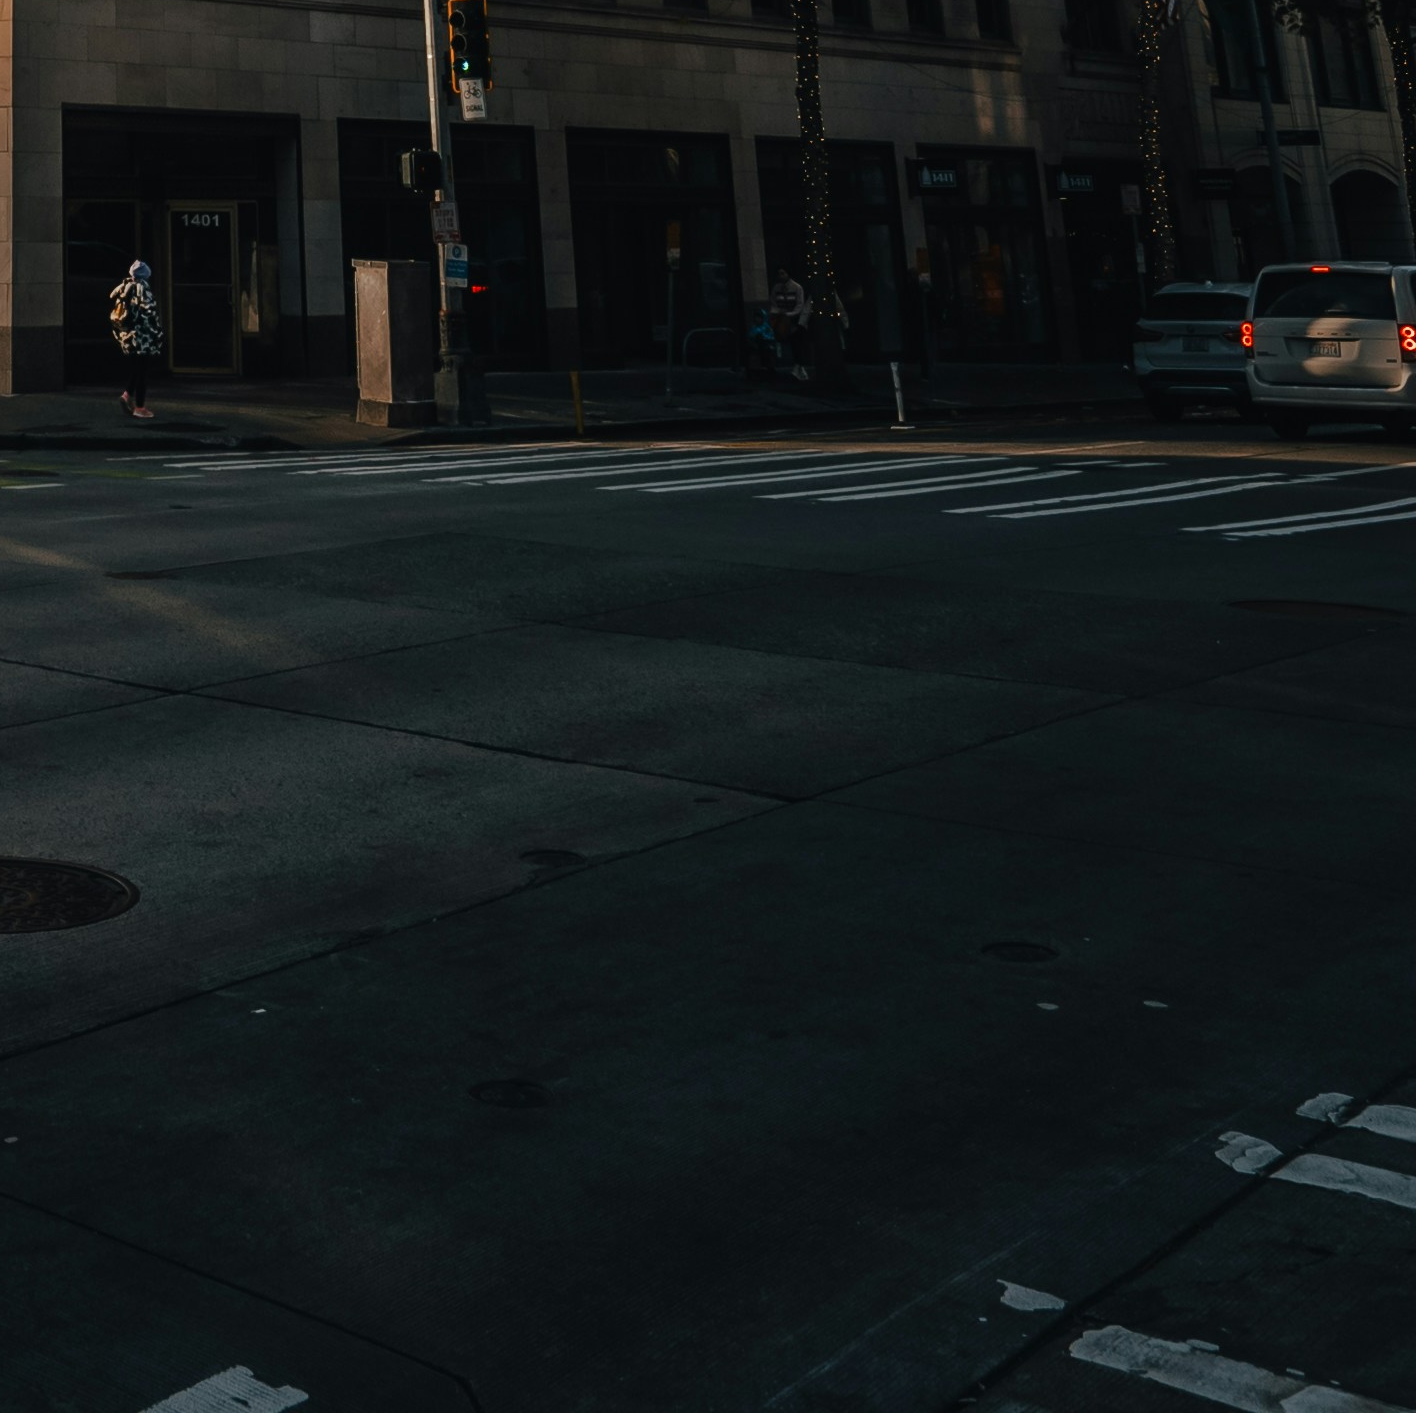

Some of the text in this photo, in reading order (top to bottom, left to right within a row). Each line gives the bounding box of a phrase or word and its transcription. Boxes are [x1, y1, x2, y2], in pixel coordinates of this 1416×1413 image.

[933, 173, 953, 182] 1411
[1070, 178, 1090, 186] 1411
[181, 213, 219, 227] 1401
